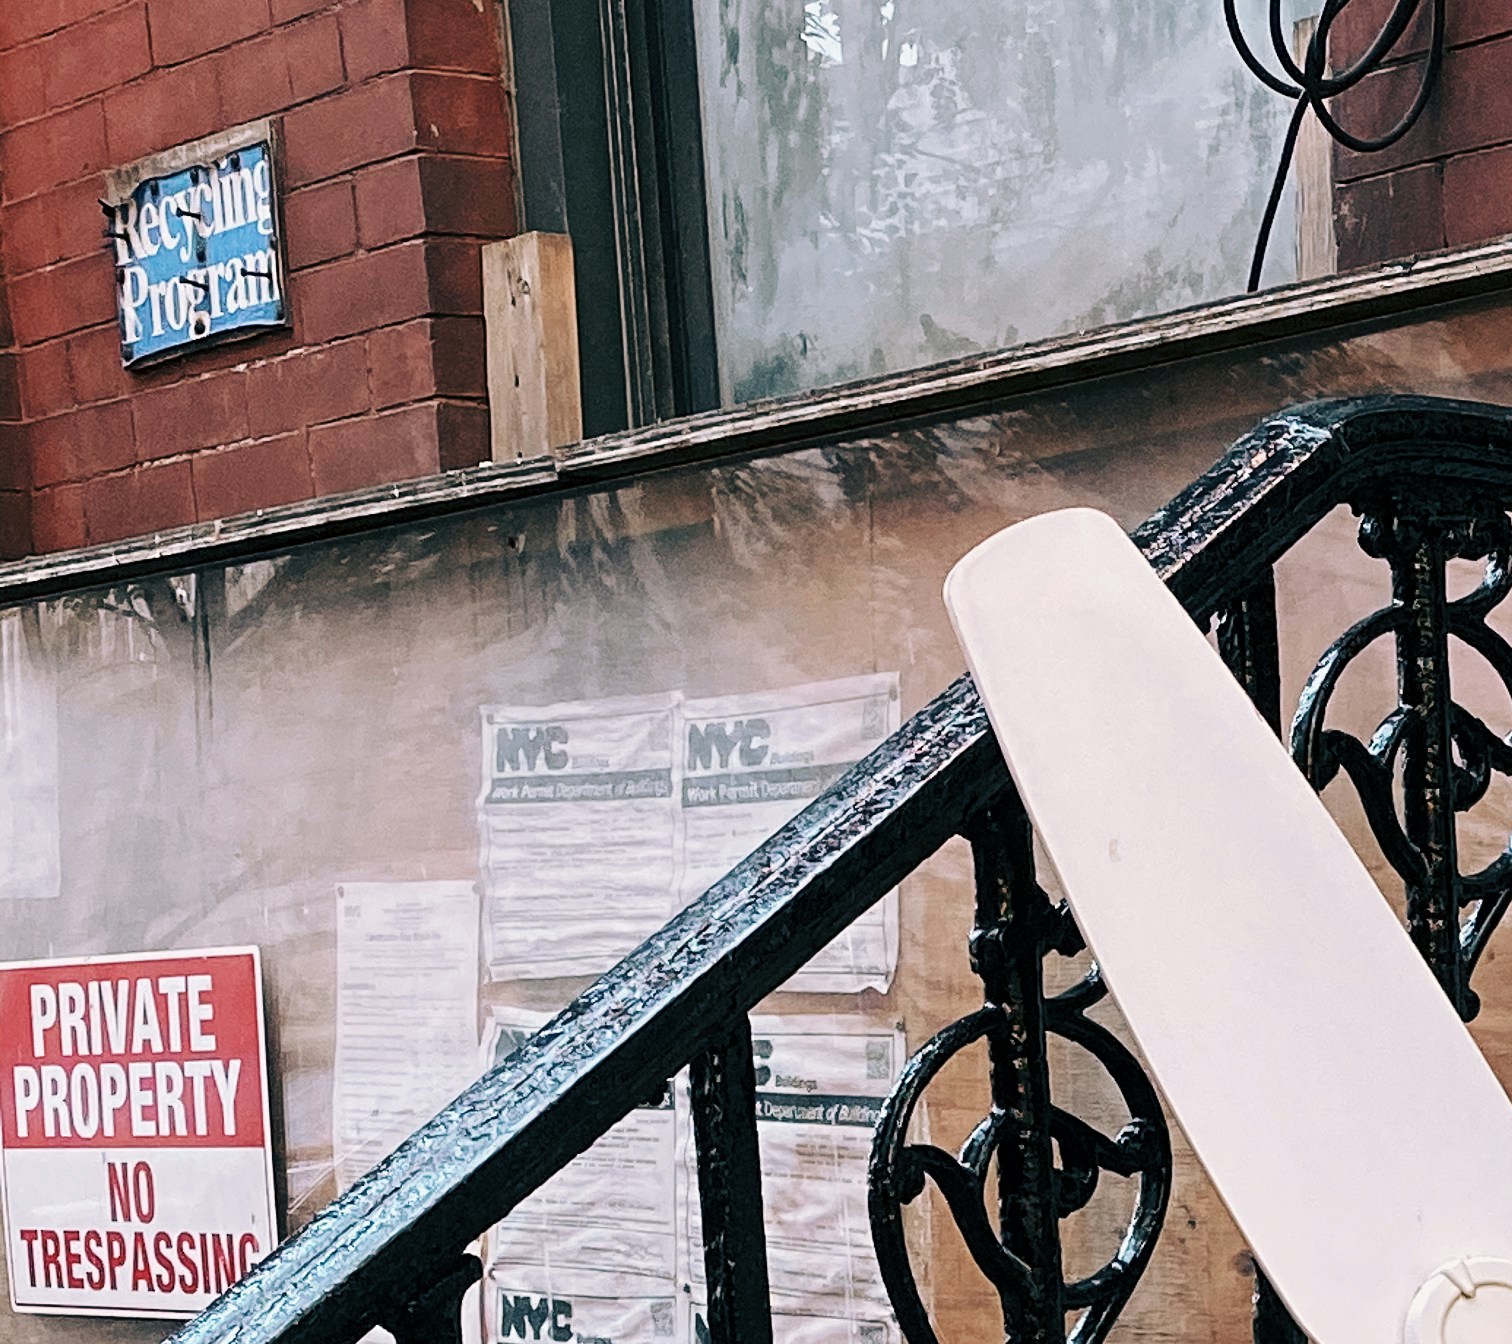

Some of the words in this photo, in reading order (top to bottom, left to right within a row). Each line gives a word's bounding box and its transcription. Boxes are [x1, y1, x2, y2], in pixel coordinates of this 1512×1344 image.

[114, 154, 274, 266] Recycling
[121, 248, 280, 345] Program
[496, 725, 569, 773] NYC
[687, 717, 771, 771] NYC
[687, 786, 717, 801] Work
[718, 783, 760, 800] Permit
[29, 973, 217, 1058] PRIVATE
[12, 1059, 242, 1139] PROPERTY
[763, 1100, 824, 1120] Department
[825, 1103, 840, 1126] of
[107, 1160, 156, 1224] NO
[501, 1293, 574, 1342] NYC
